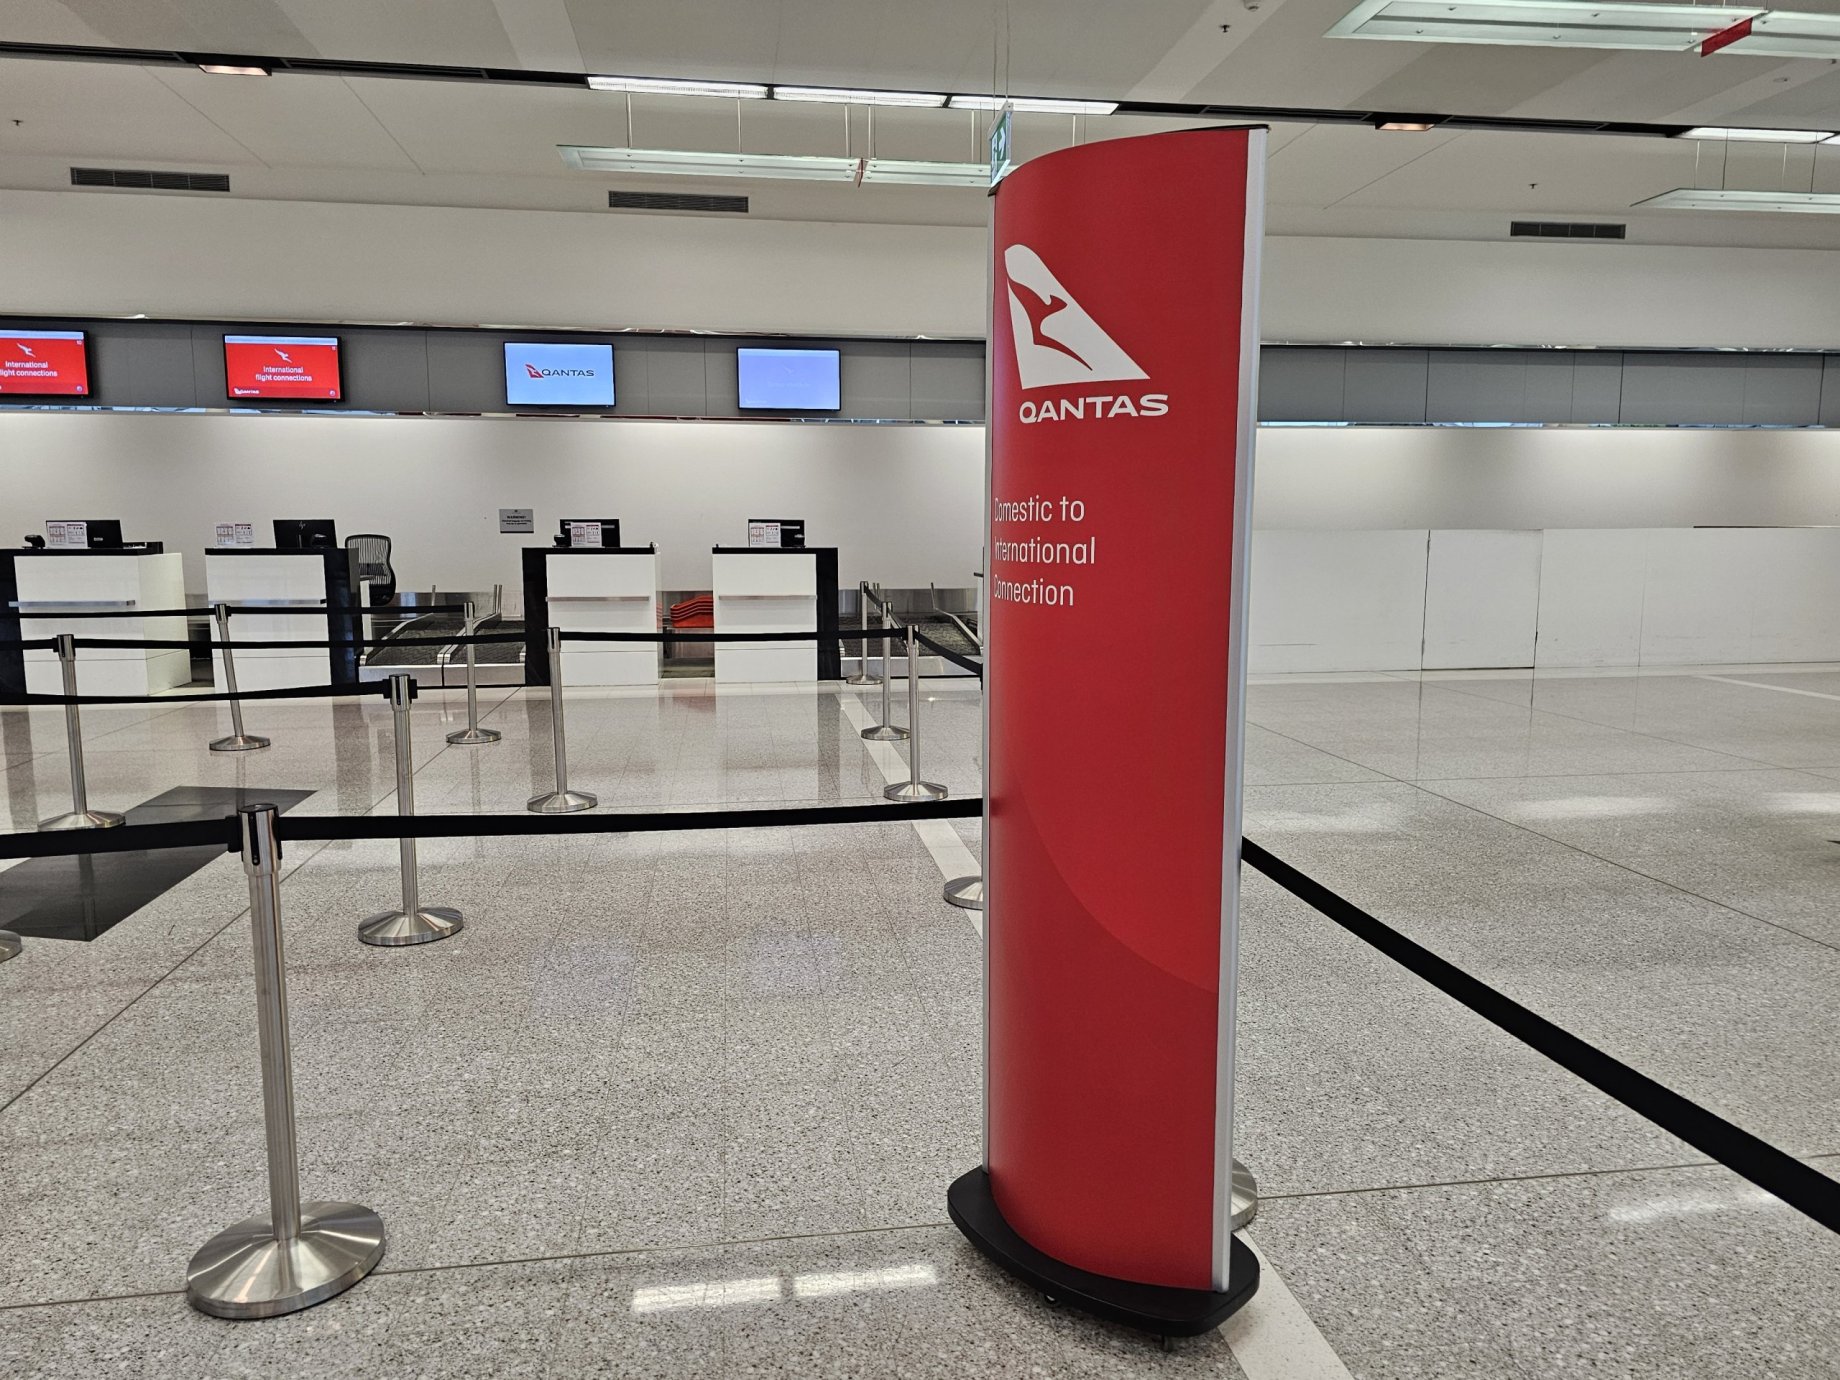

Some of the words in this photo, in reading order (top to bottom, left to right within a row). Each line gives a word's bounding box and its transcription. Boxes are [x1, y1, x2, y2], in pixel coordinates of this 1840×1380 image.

[5, 361, 48, 369] International
[255, 374, 272, 382] flight
[541, 368, 595, 377] QANTAS
[1019, 394, 1169, 424] QANTAS
[993, 495, 1052, 522] Domestic
[1060, 496, 1085, 522] to
[994, 536, 1096, 565] International
[993, 574, 1074, 606] Connection
